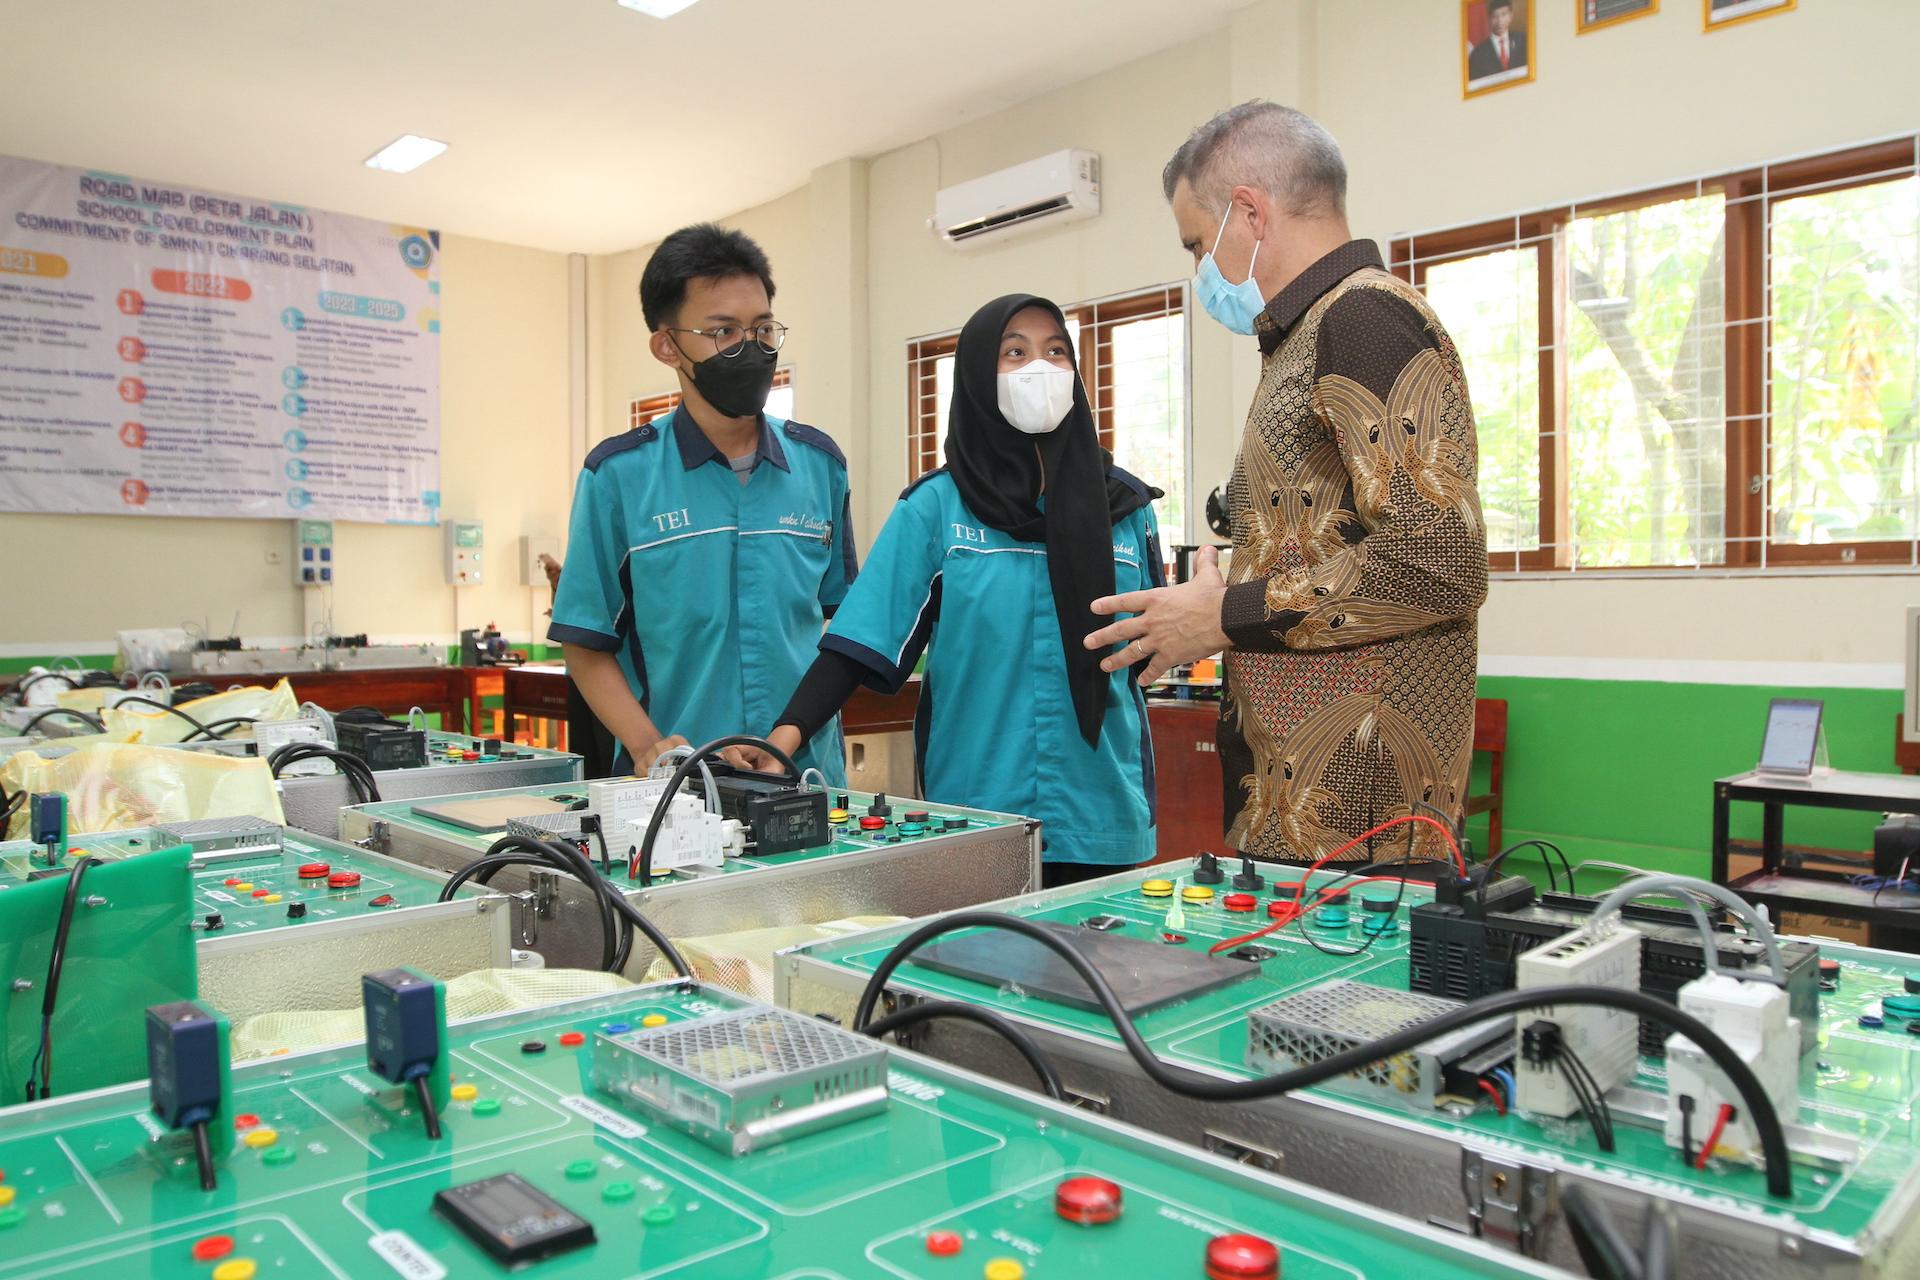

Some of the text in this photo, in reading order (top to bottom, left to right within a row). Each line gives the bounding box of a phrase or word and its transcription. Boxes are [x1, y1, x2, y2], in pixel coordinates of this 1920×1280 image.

[80, 176, 136, 202] ROAD
[141, 186, 184, 207] MAP
[189, 194, 241, 217] (PETA
[246, 205, 301, 228] JALAN
[15, 211, 131, 243] COMMITMENT
[134, 229, 155, 245] OF
[159, 233, 203, 251] SMKN
[216, 242, 291, 266] CIKARANG
[292, 254, 355, 276] SELATAN
[77, 199, 314, 251] SCHOOL DEVELOPMENT PLAN
[325, 295, 357, 313] 2023
[368, 300, 400, 318] 2025
[653, 508, 692, 532] TEI
[951, 523, 987, 543] TEI
